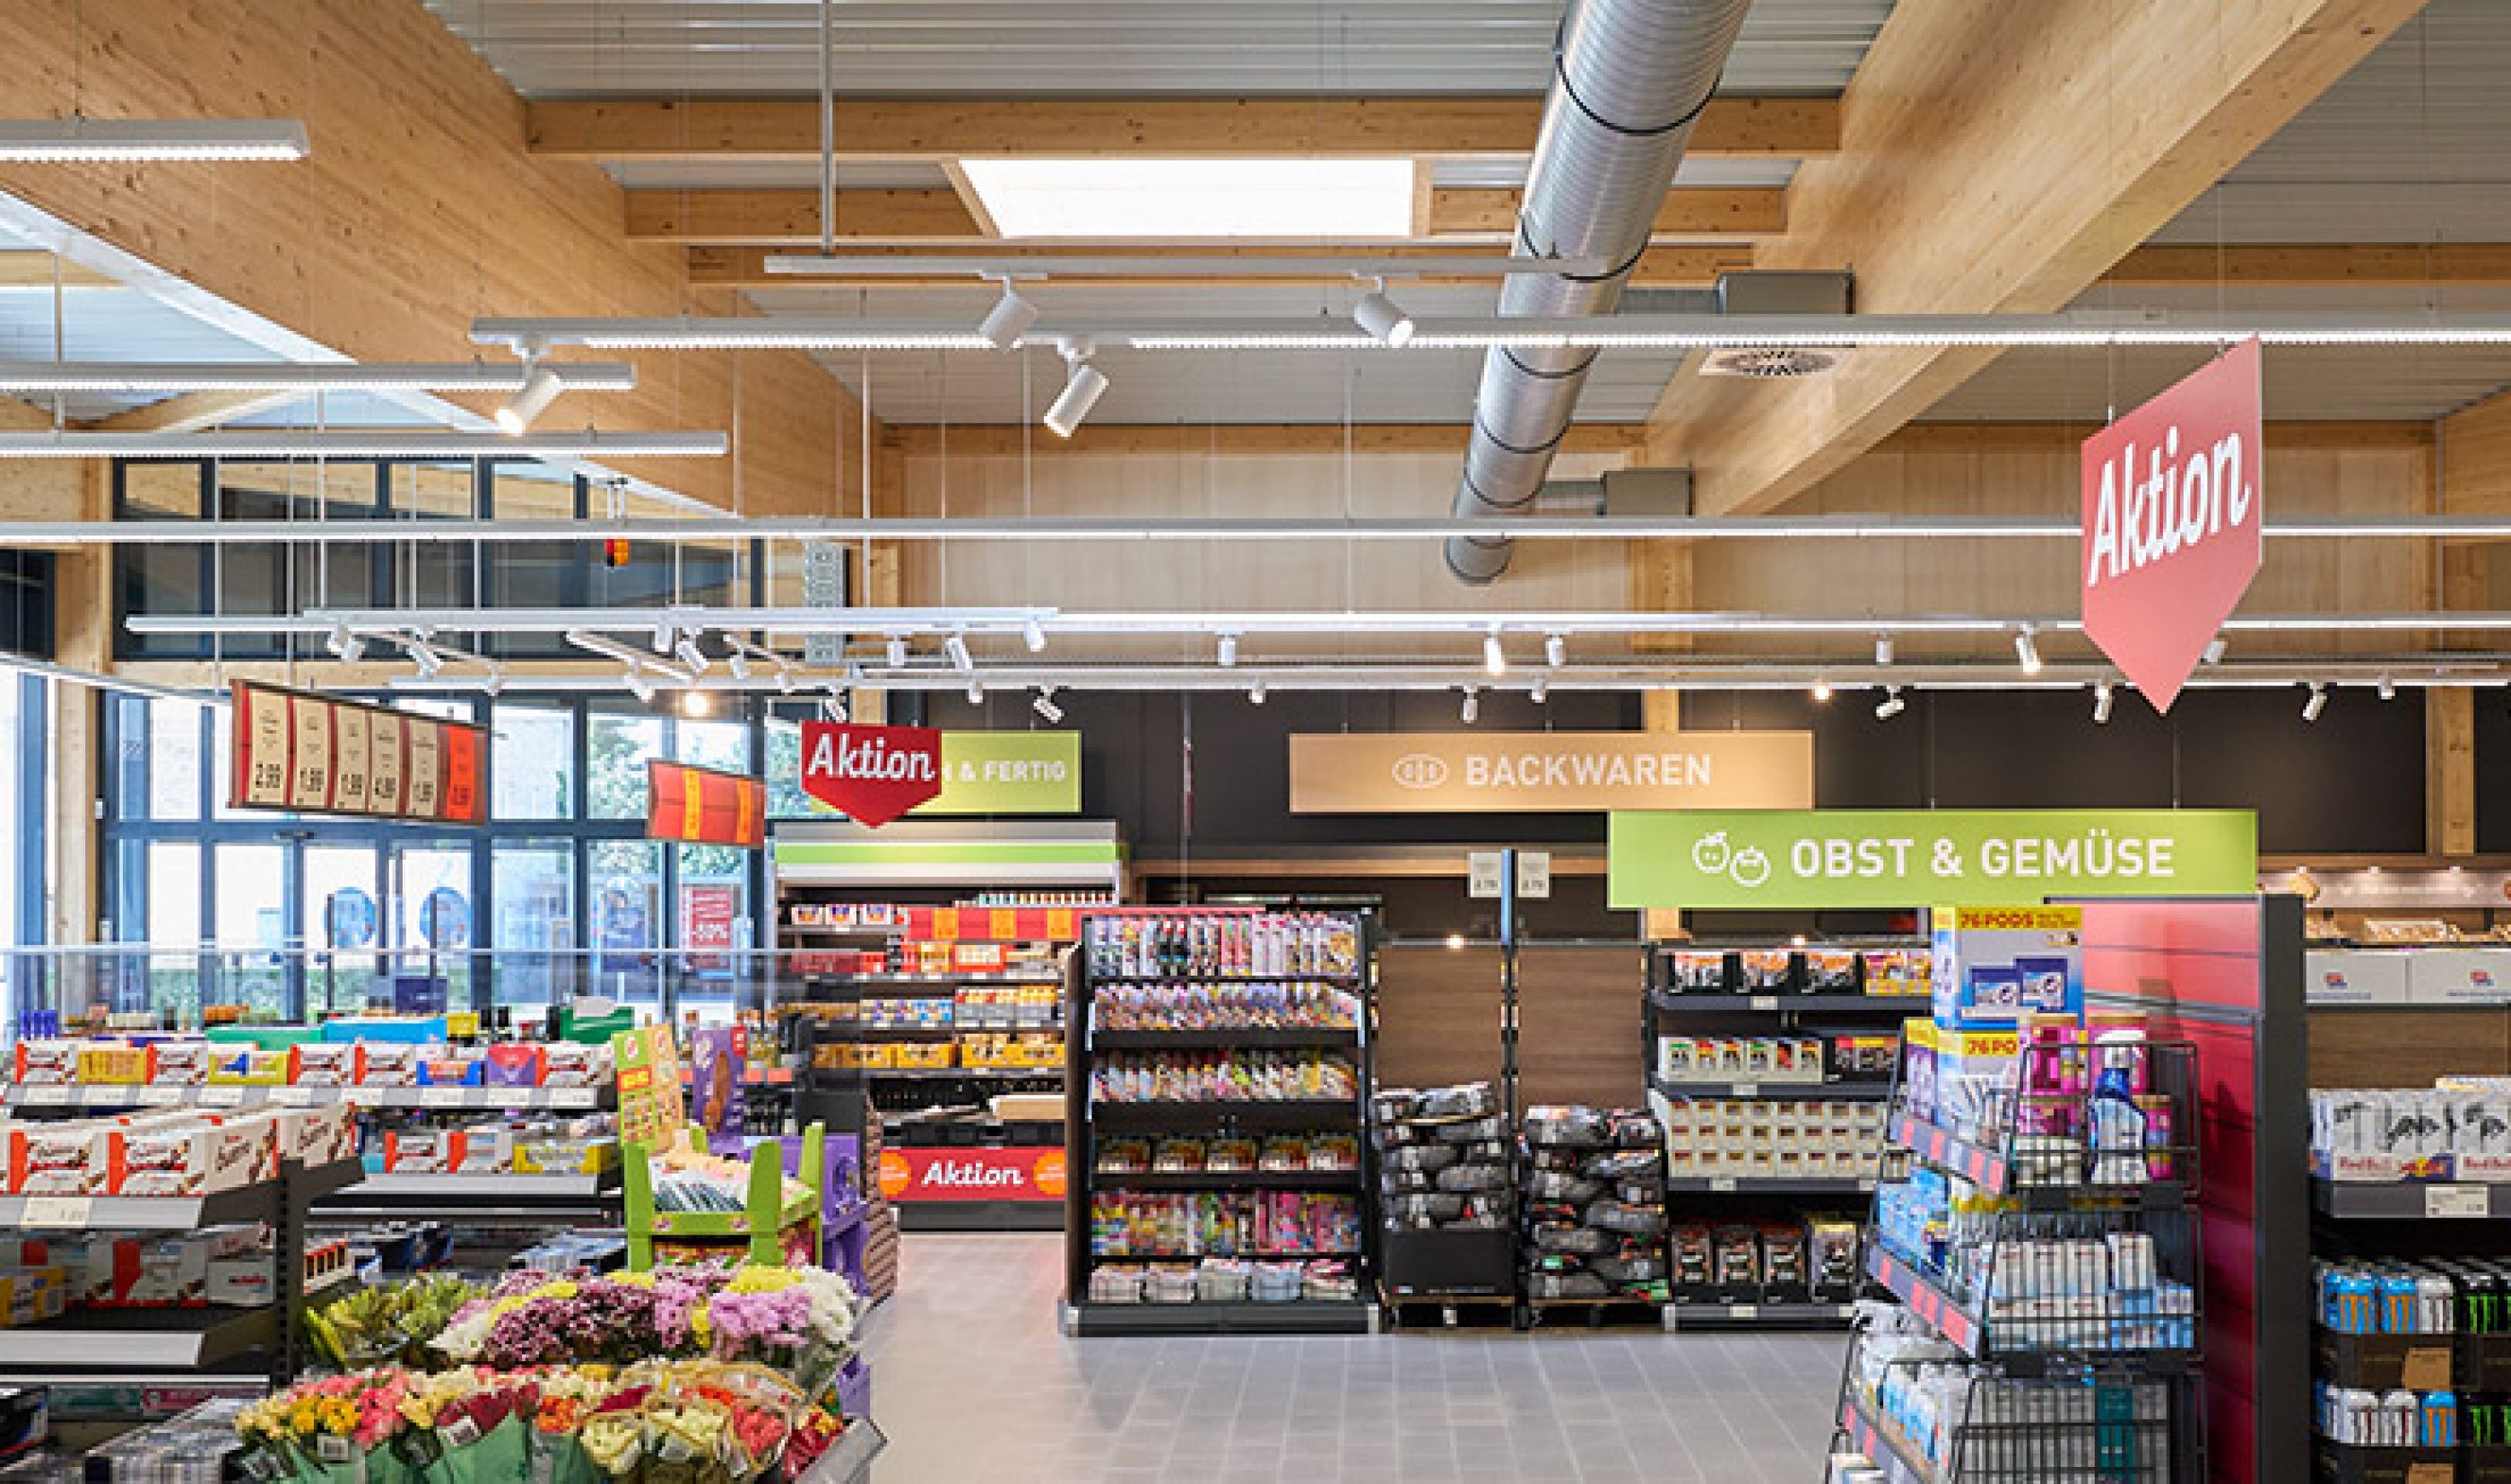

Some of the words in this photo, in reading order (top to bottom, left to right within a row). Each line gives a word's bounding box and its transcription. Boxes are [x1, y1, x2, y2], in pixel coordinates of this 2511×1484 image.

[2087, 427, 2252, 586] Aktion
[808, 733, 935, 781] Aktion
[960, 760, 977, 781] &
[986, 759, 1068, 781] FERTIG
[1466, 753, 1711, 786] BACKWAREN
[1794, 838, 1915, 878] OBST
[1932, 838, 1965, 878] &
[1980, 829, 2175, 878] GEMÜSE
[1992, 1039, 2017, 1054] PO
[921, 1159, 1024, 1188] Aktion
